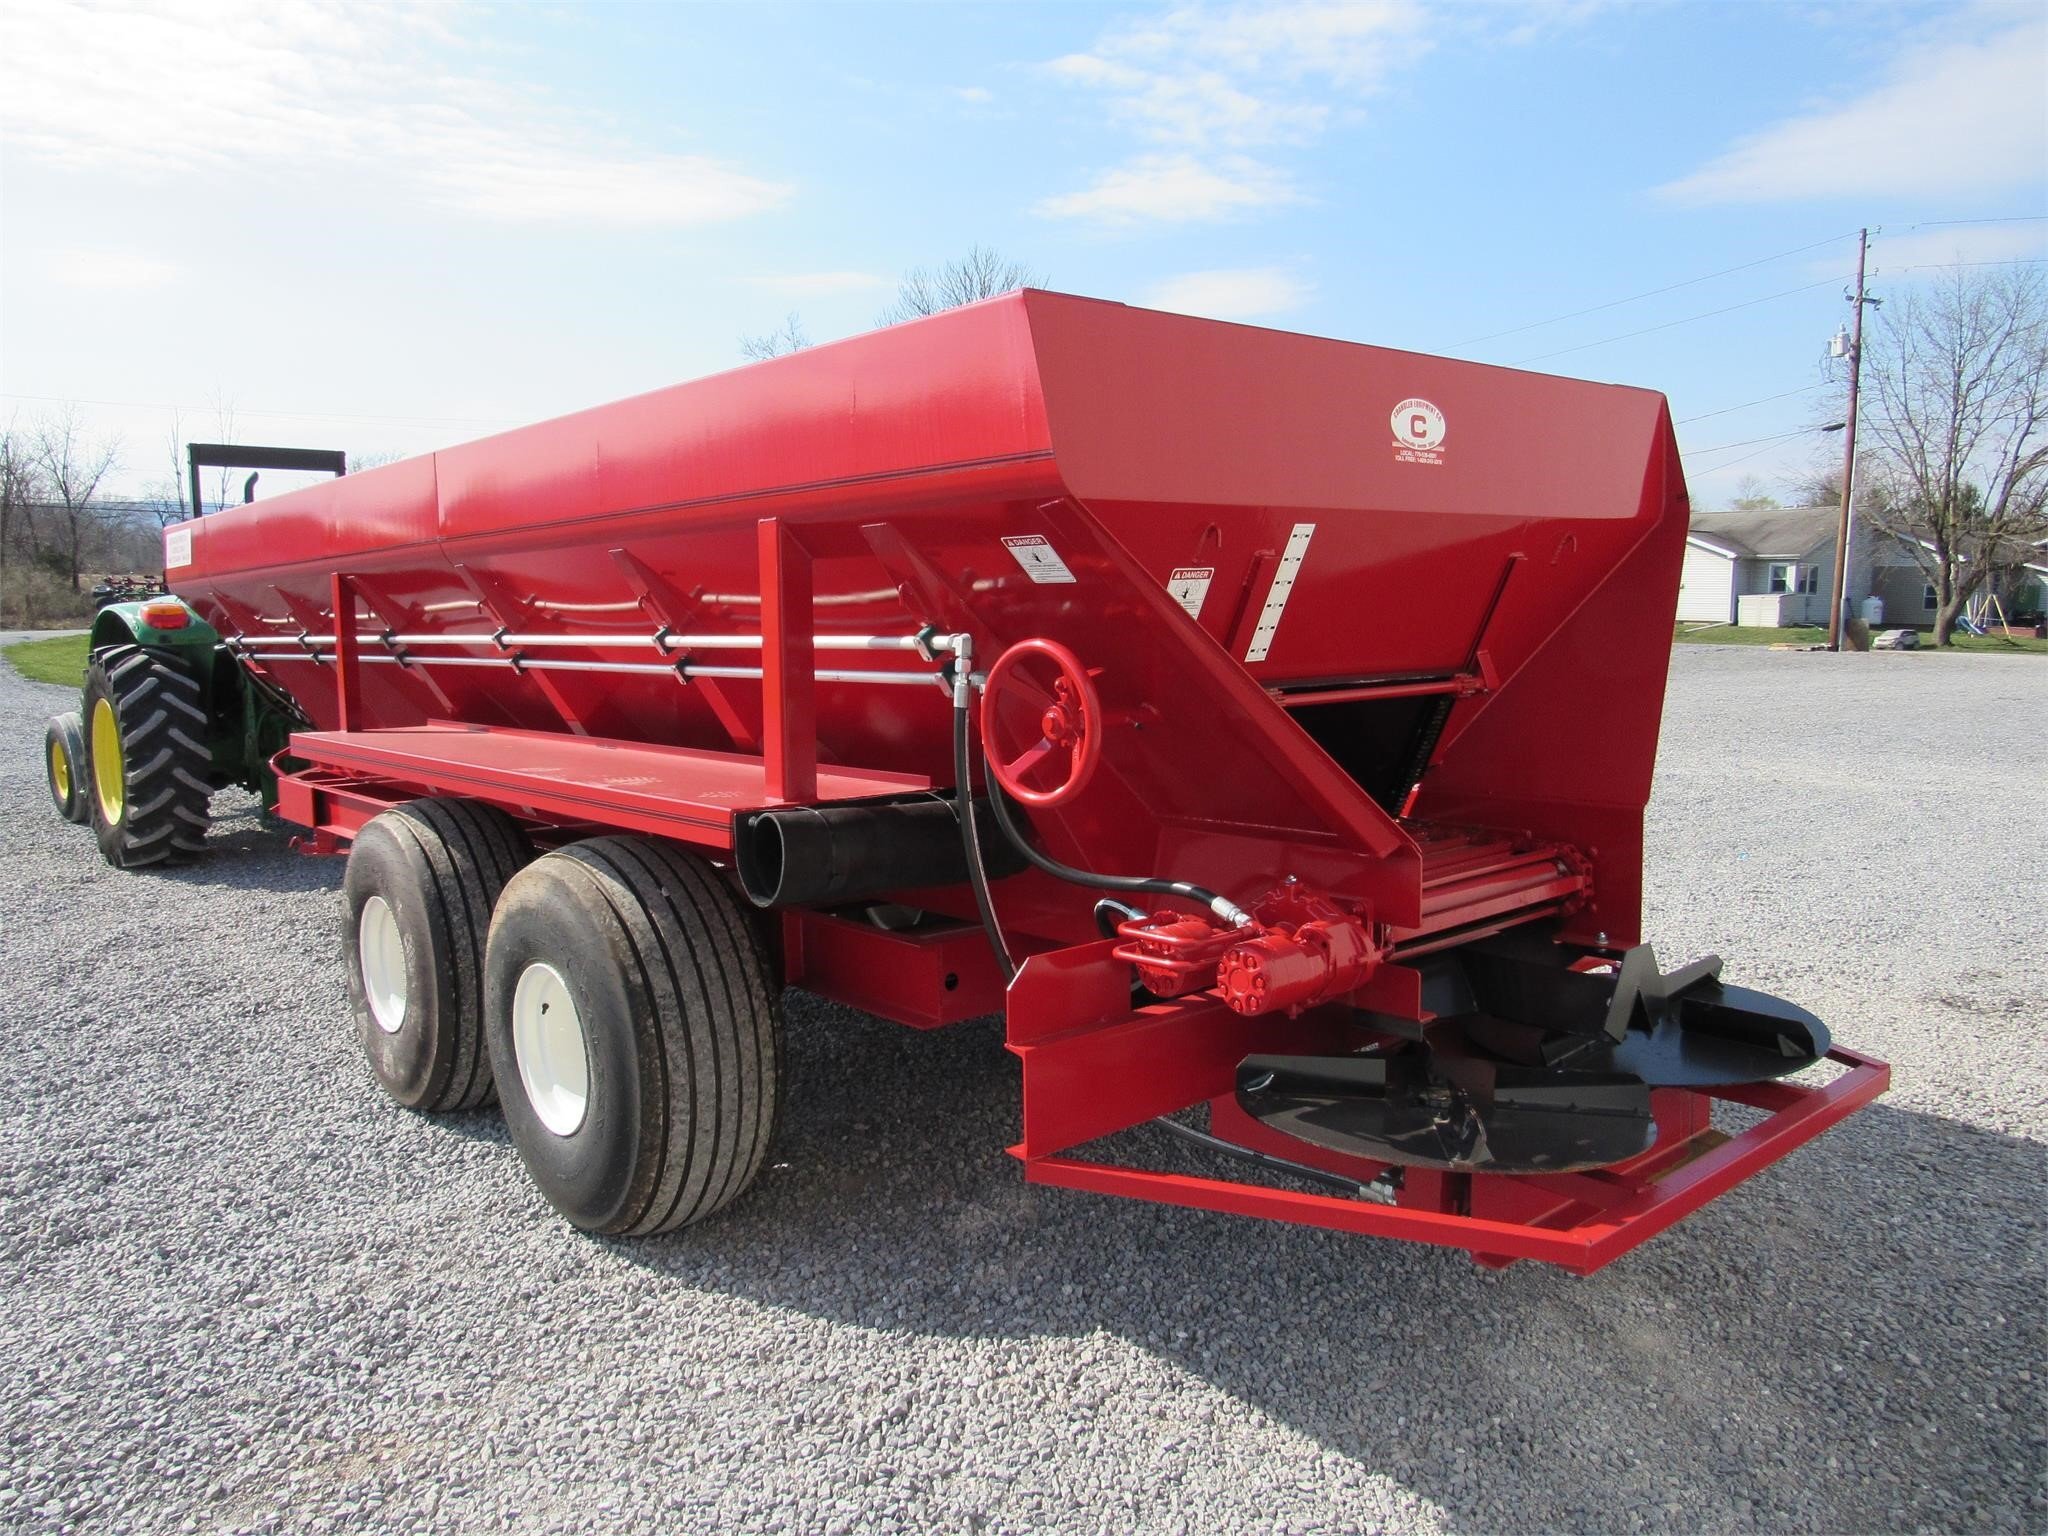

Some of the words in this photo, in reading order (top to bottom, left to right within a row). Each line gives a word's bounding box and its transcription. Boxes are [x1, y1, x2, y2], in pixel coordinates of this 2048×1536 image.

[1410, 414, 1427, 439] C
[1013, 537, 1044, 546] DANGER
[1181, 570, 1209, 579] DANGER
